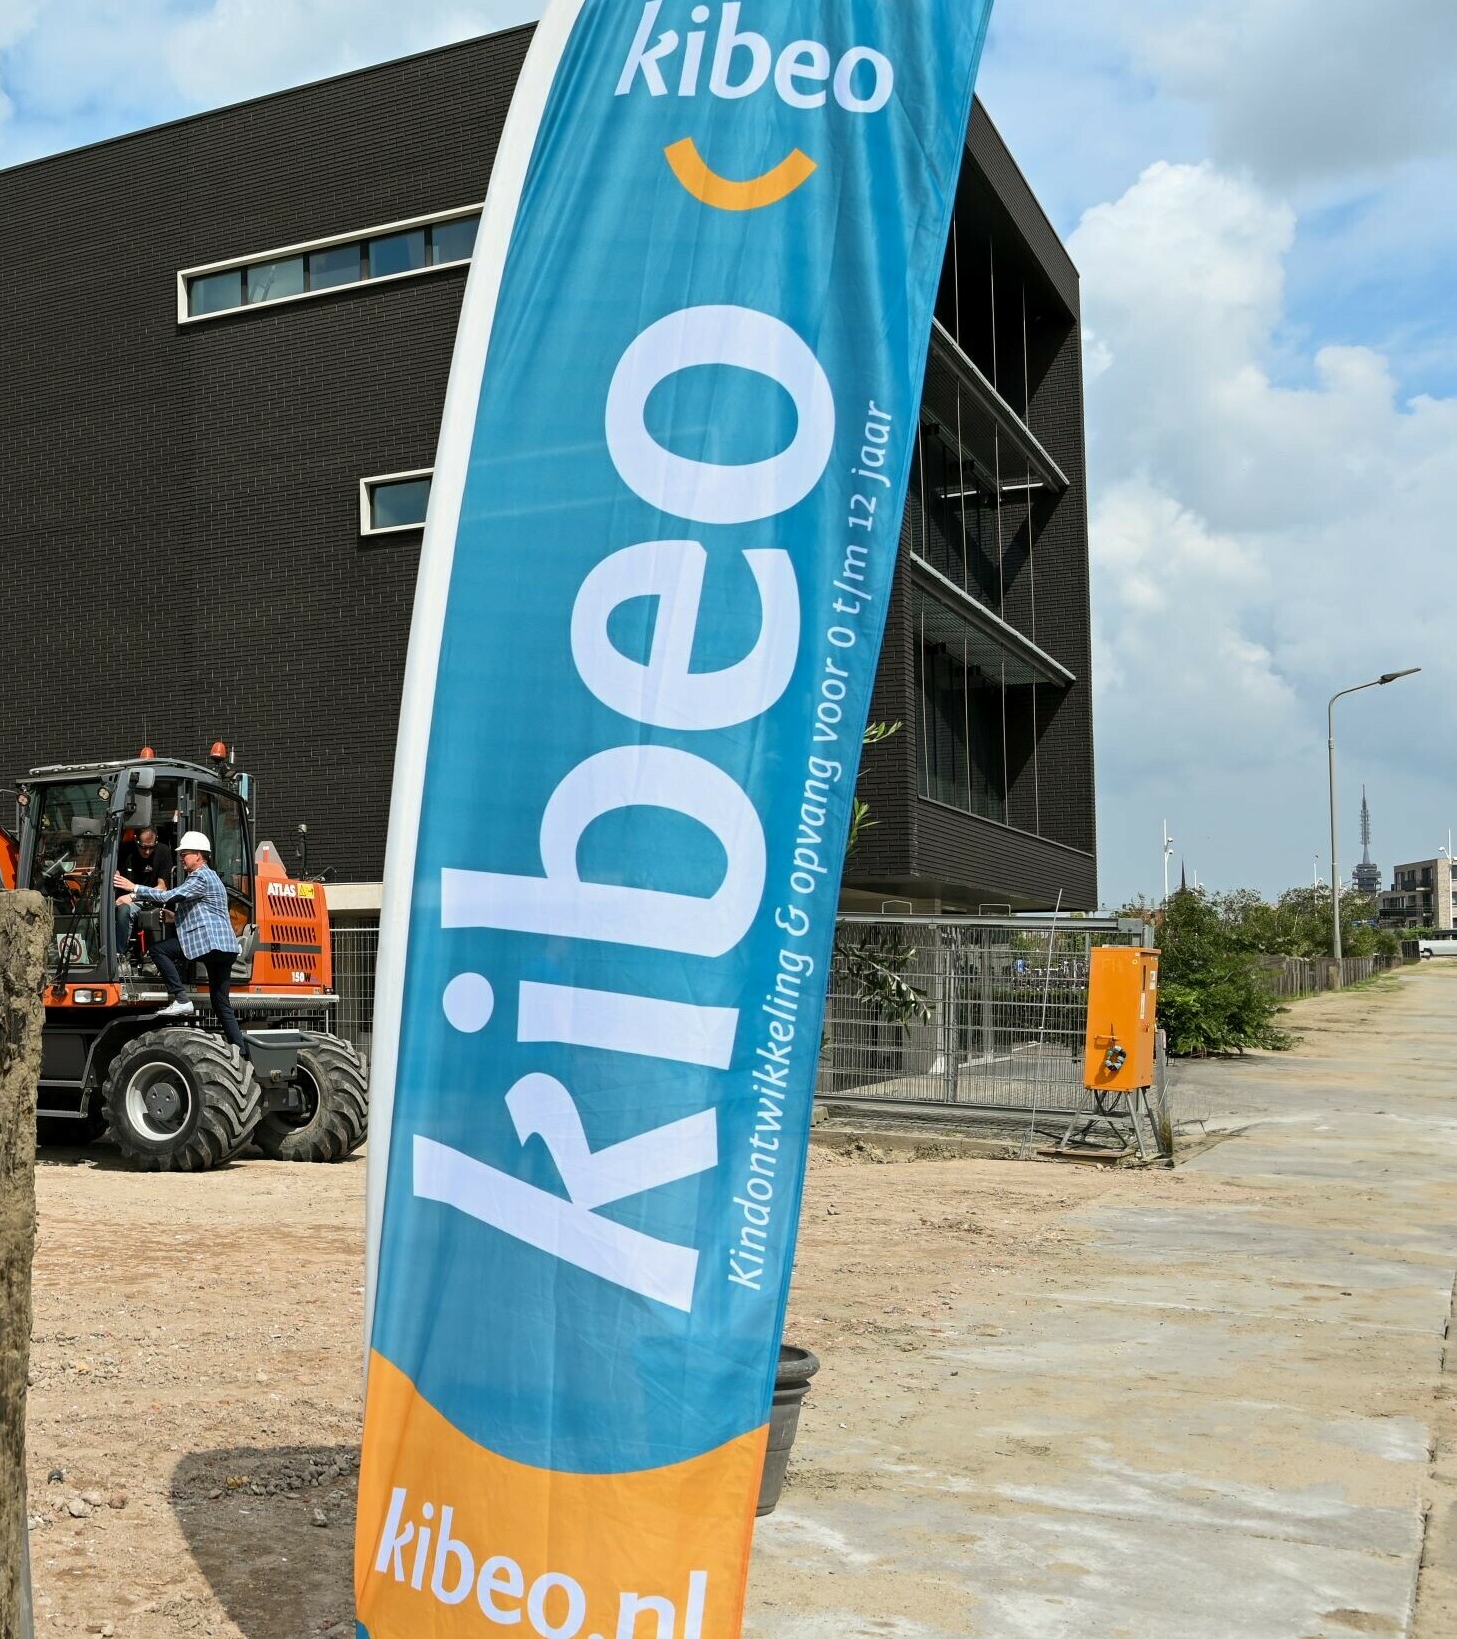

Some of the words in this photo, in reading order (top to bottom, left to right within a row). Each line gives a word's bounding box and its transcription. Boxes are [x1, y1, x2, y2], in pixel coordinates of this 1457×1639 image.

[614, 0, 894, 113] kibeo
[851, 400, 892, 488] jaar
[848, 494, 877, 532] 12
[832, 545, 873, 614] t/m
[827, 626, 856, 648] 0
[813, 657, 849, 742] voor
[413, 305, 835, 1312] kibeo
[791, 756, 841, 894] opvang
[267, 882, 297, 897] ATLAS
[775, 905, 809, 936] &
[728, 949, 814, 1290] Kindontwikkeling
